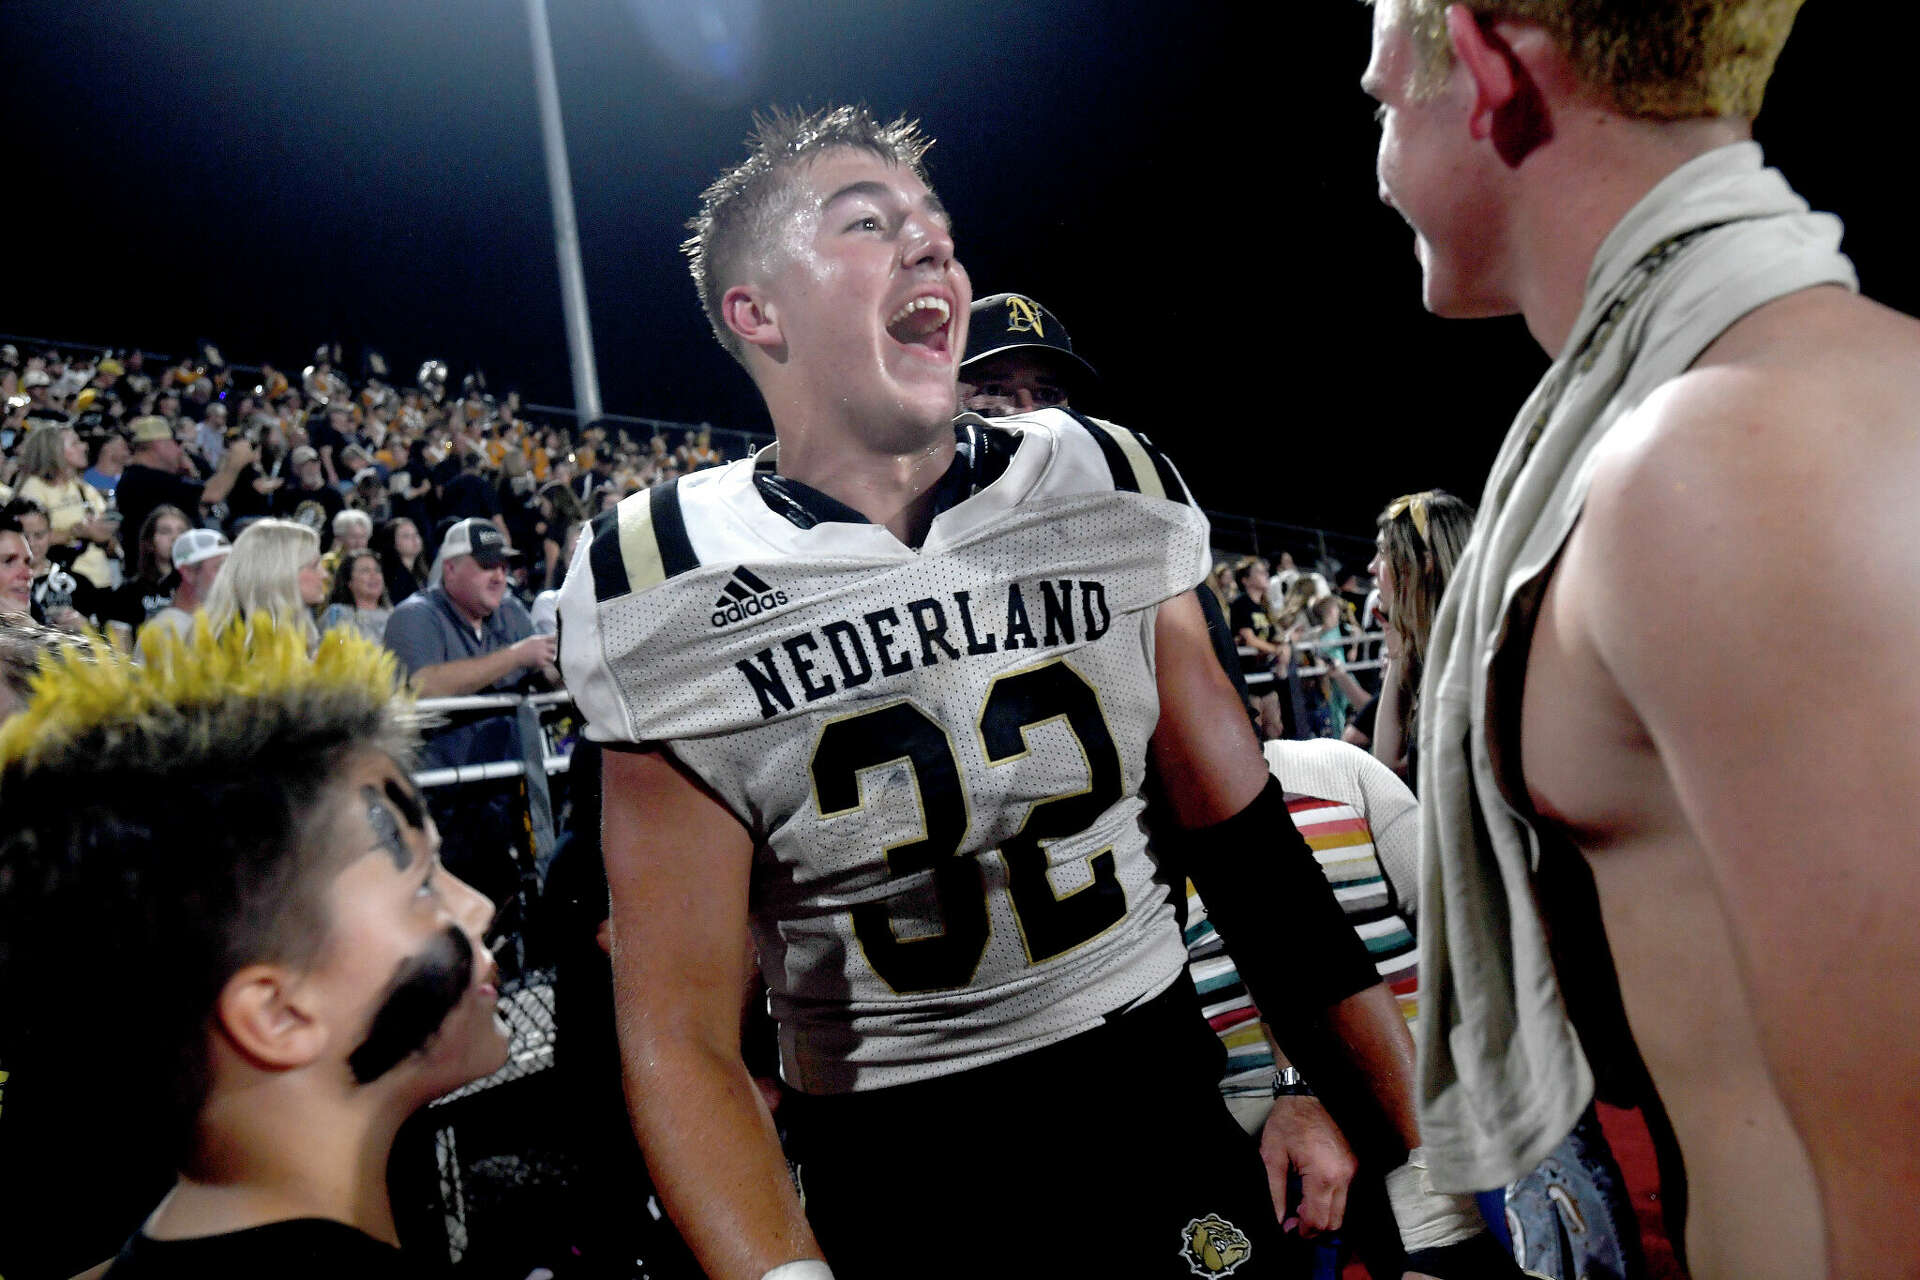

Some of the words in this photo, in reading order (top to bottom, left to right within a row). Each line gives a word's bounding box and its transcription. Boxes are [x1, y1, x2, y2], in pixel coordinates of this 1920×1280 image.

[711, 590, 789, 628] adidas
[735, 579, 1111, 720] NEDERLAND
[808, 657, 1129, 996] 32
